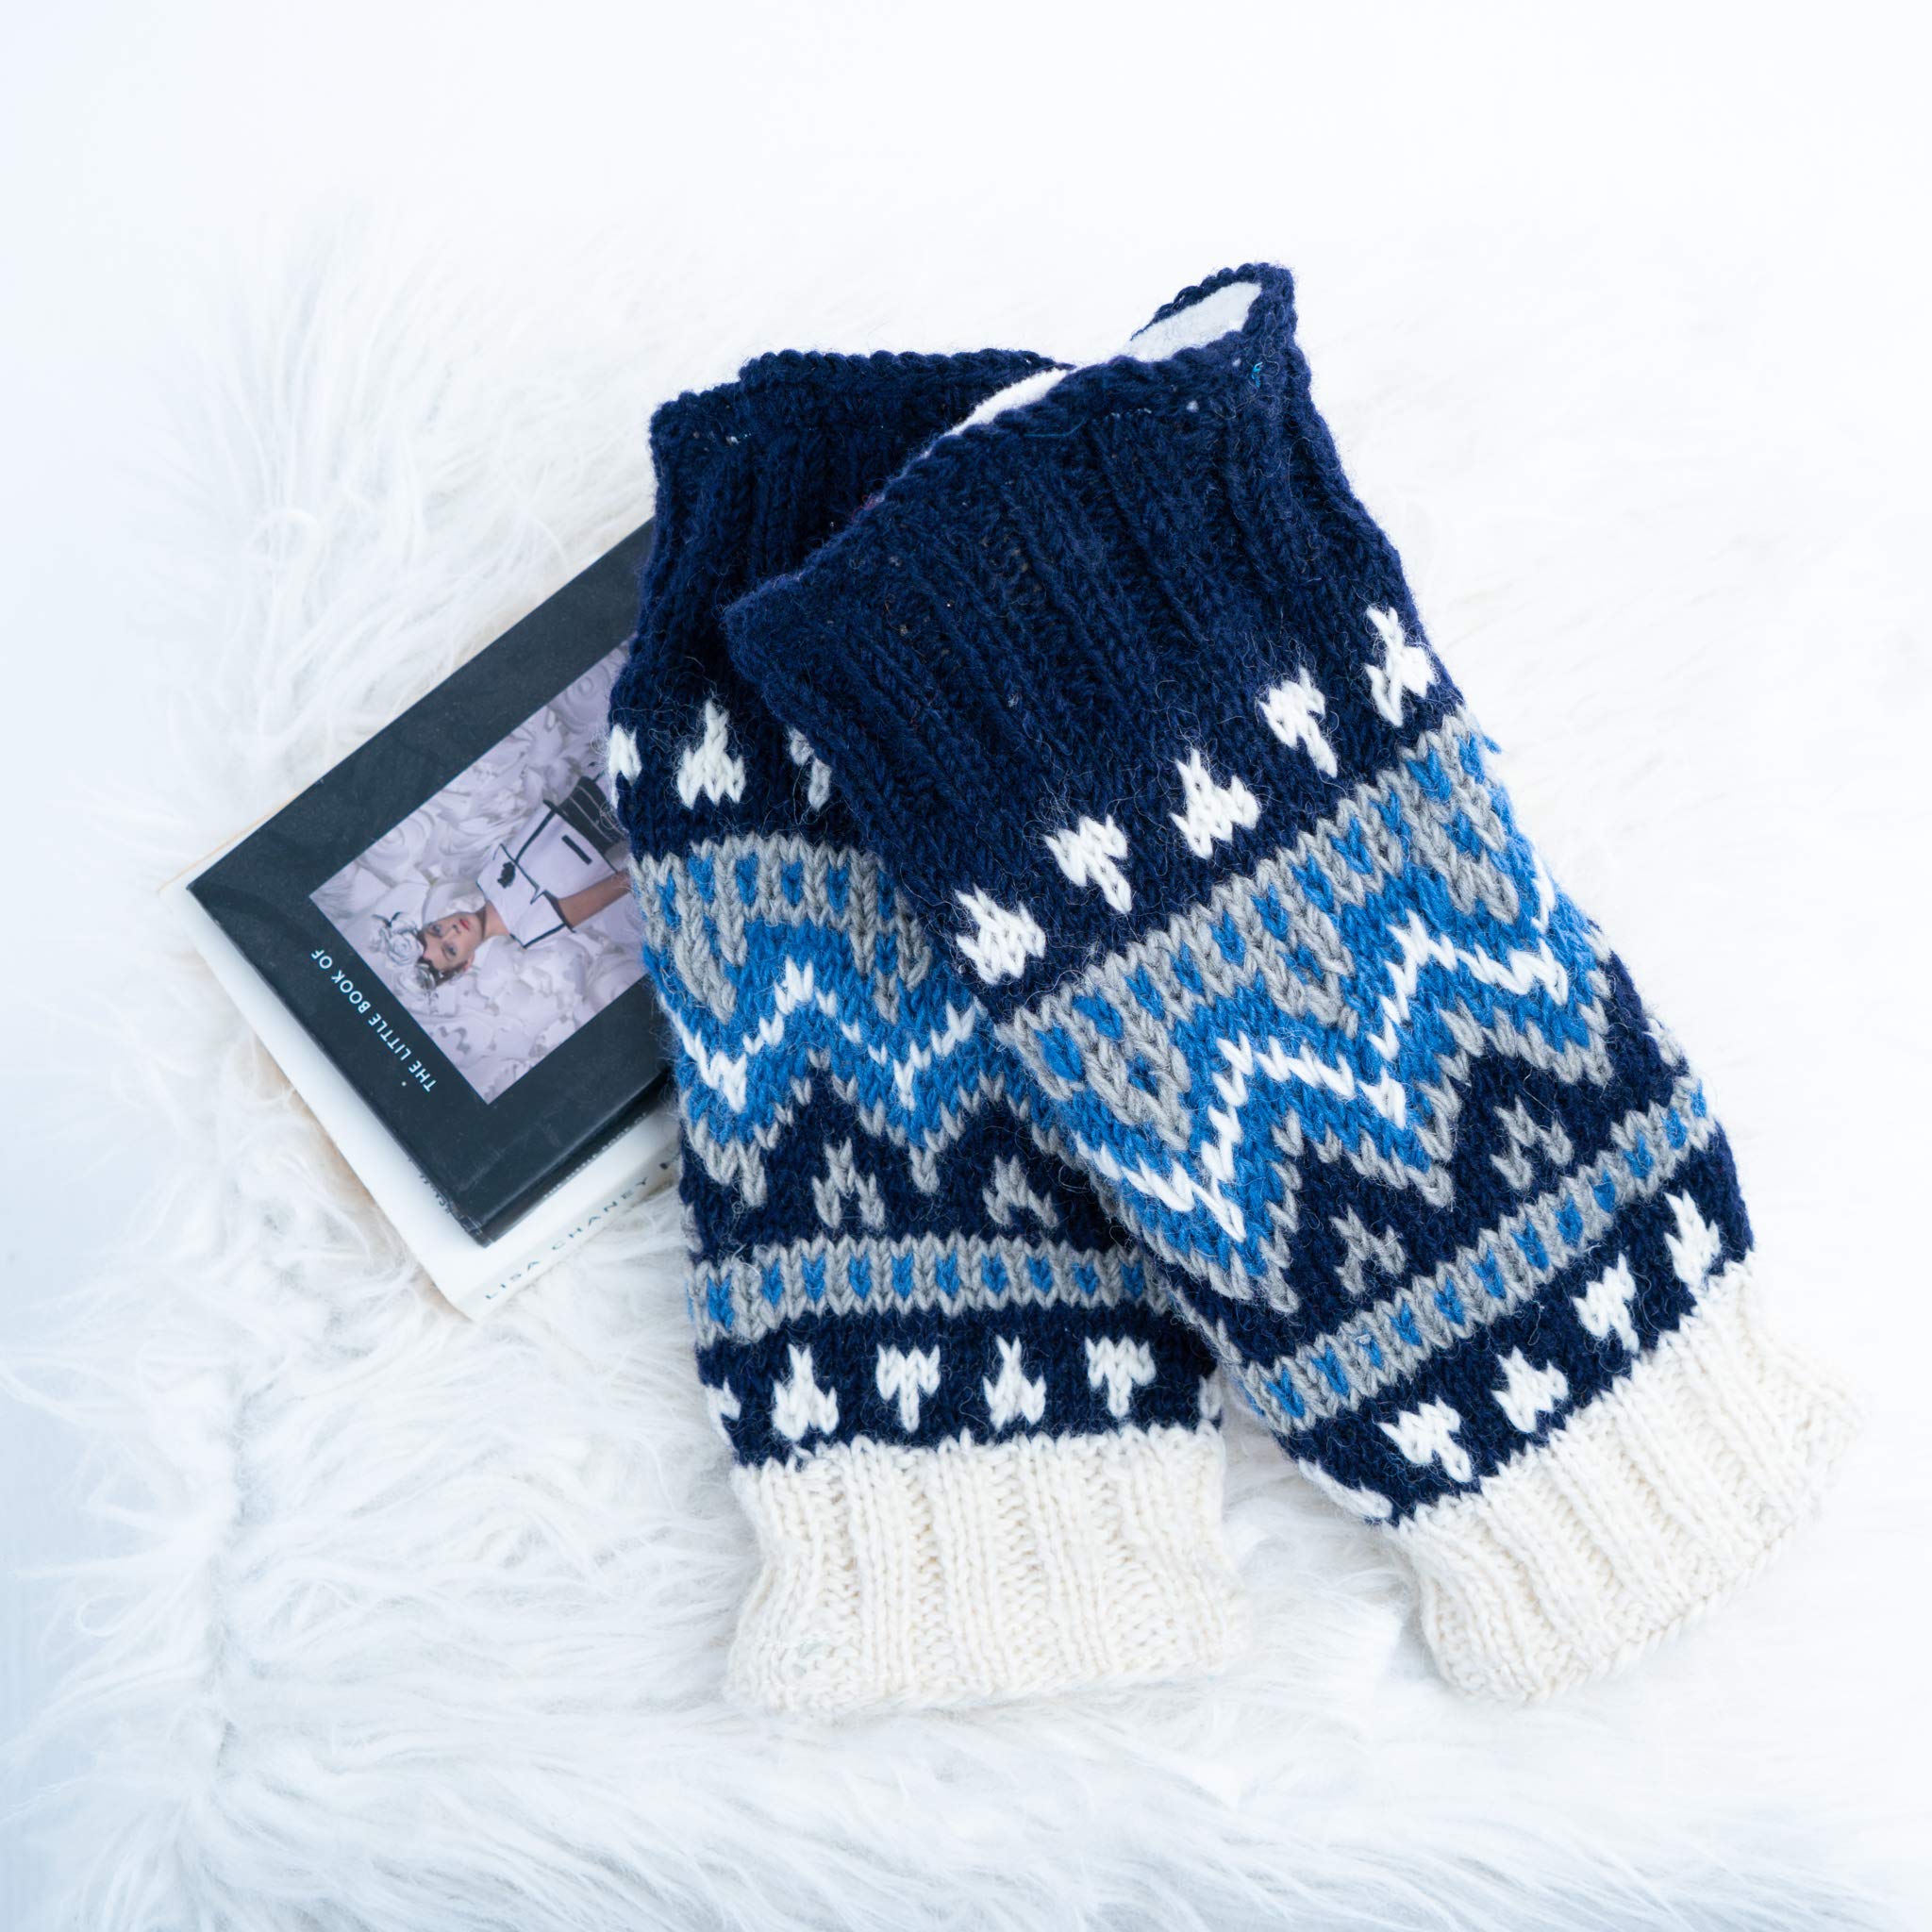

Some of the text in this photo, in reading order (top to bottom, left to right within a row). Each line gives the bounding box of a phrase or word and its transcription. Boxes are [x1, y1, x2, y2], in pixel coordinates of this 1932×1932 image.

[311, 949, 437, 1091] THE LITTLE BOOK OF
[485, 1177, 648, 1300] LISA CHANEY
